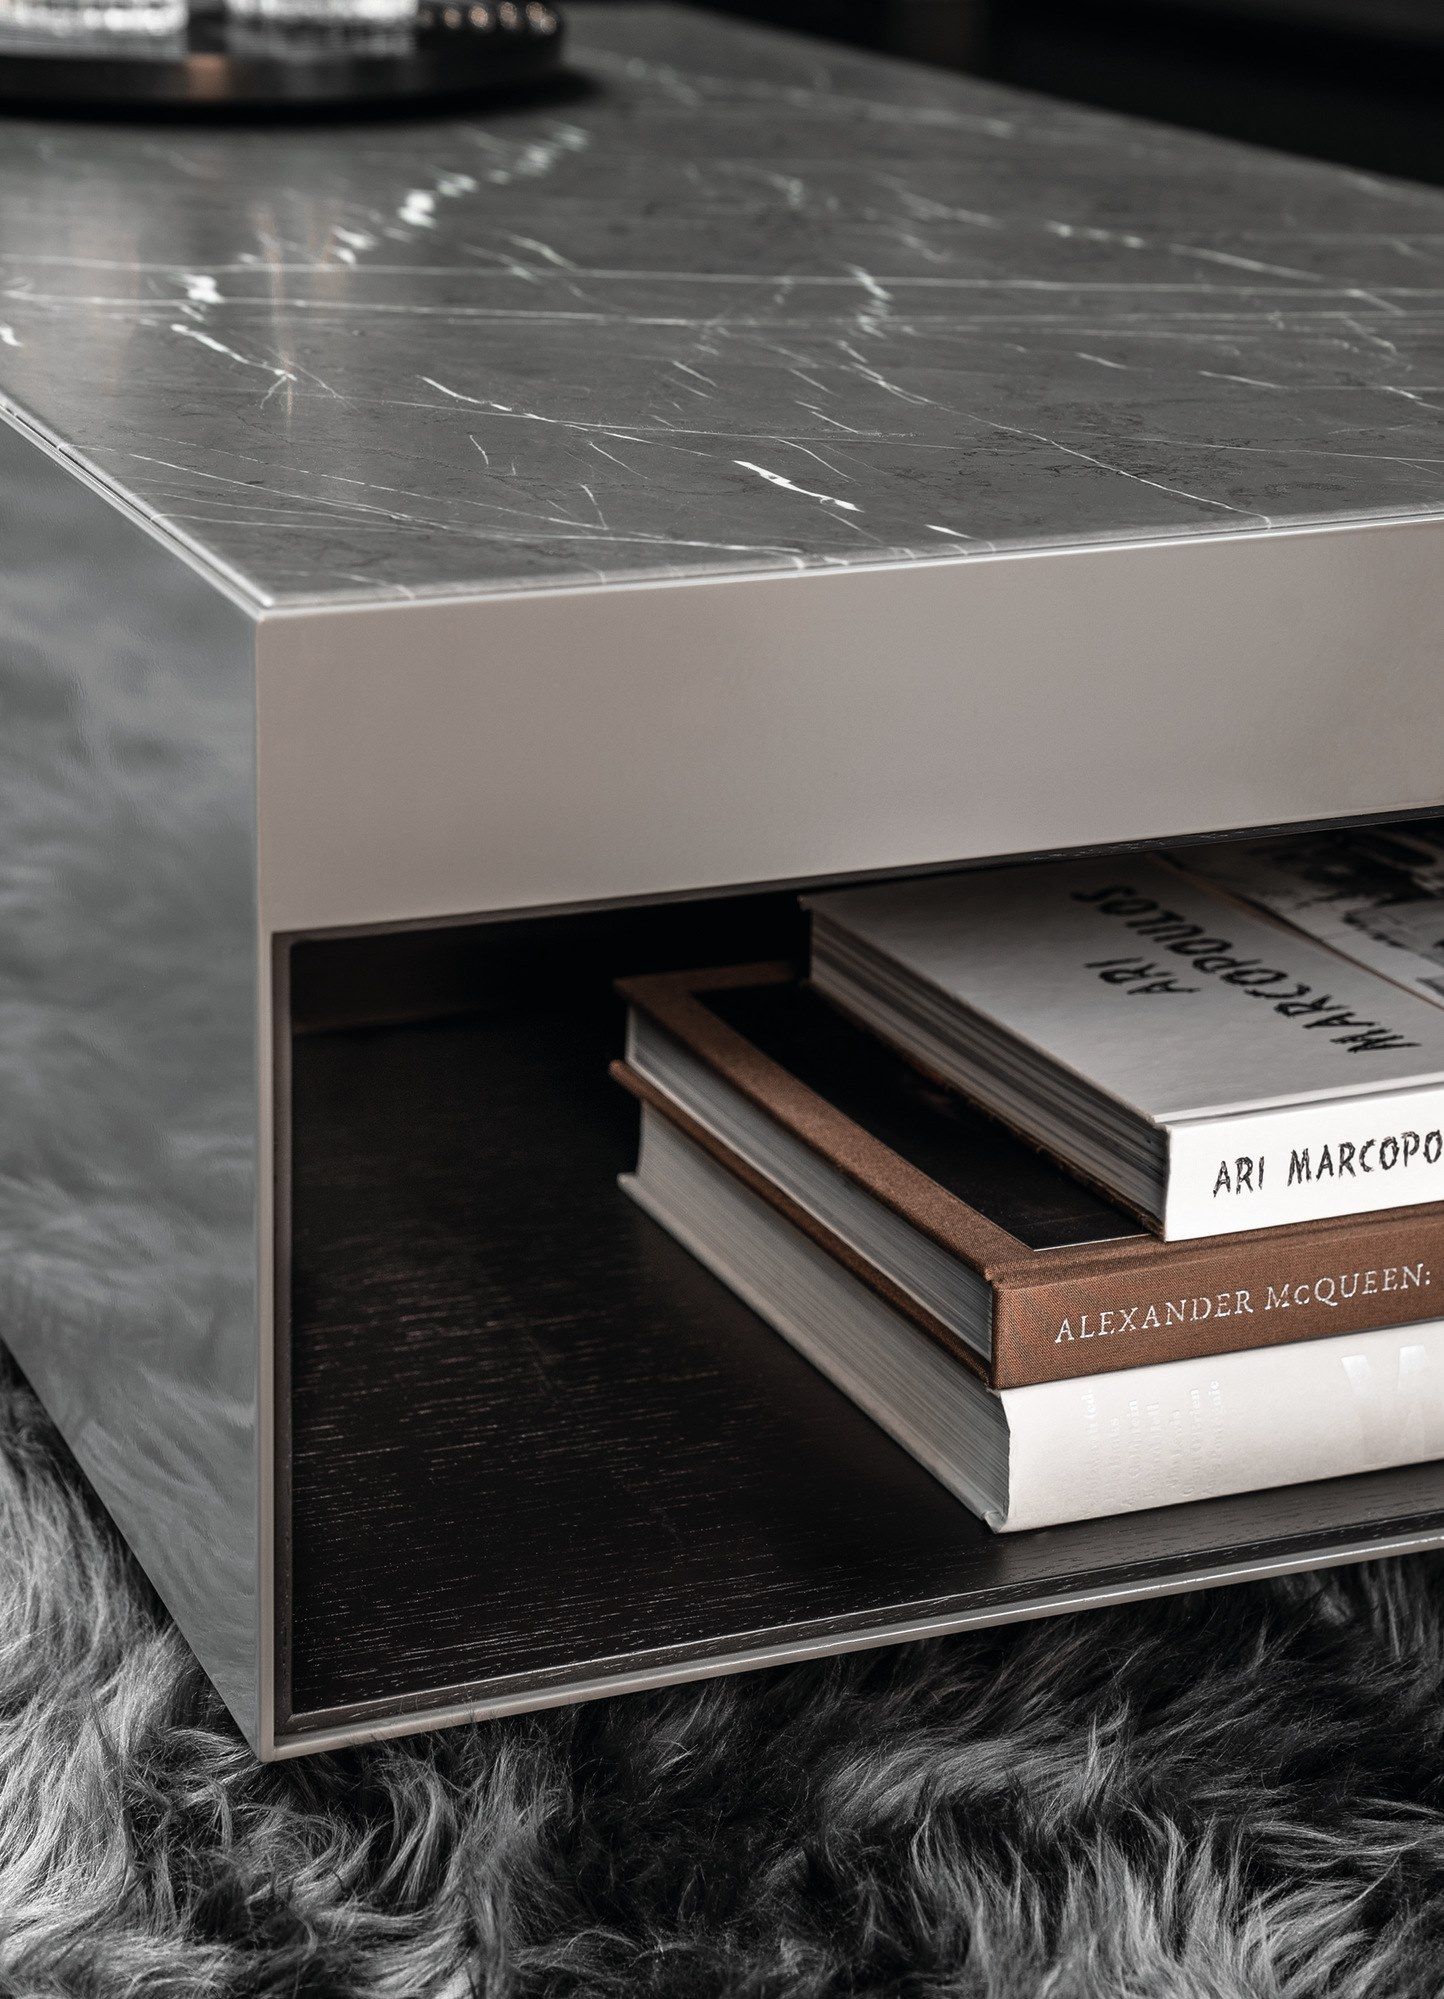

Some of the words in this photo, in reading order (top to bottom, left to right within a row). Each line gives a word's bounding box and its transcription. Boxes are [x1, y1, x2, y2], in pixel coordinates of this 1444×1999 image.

[1213, 1156, 1265, 1198] ARI
[1287, 1129, 1443, 1187] MARCOPO
[1054, 1289, 1254, 1344] ALEXANDER
